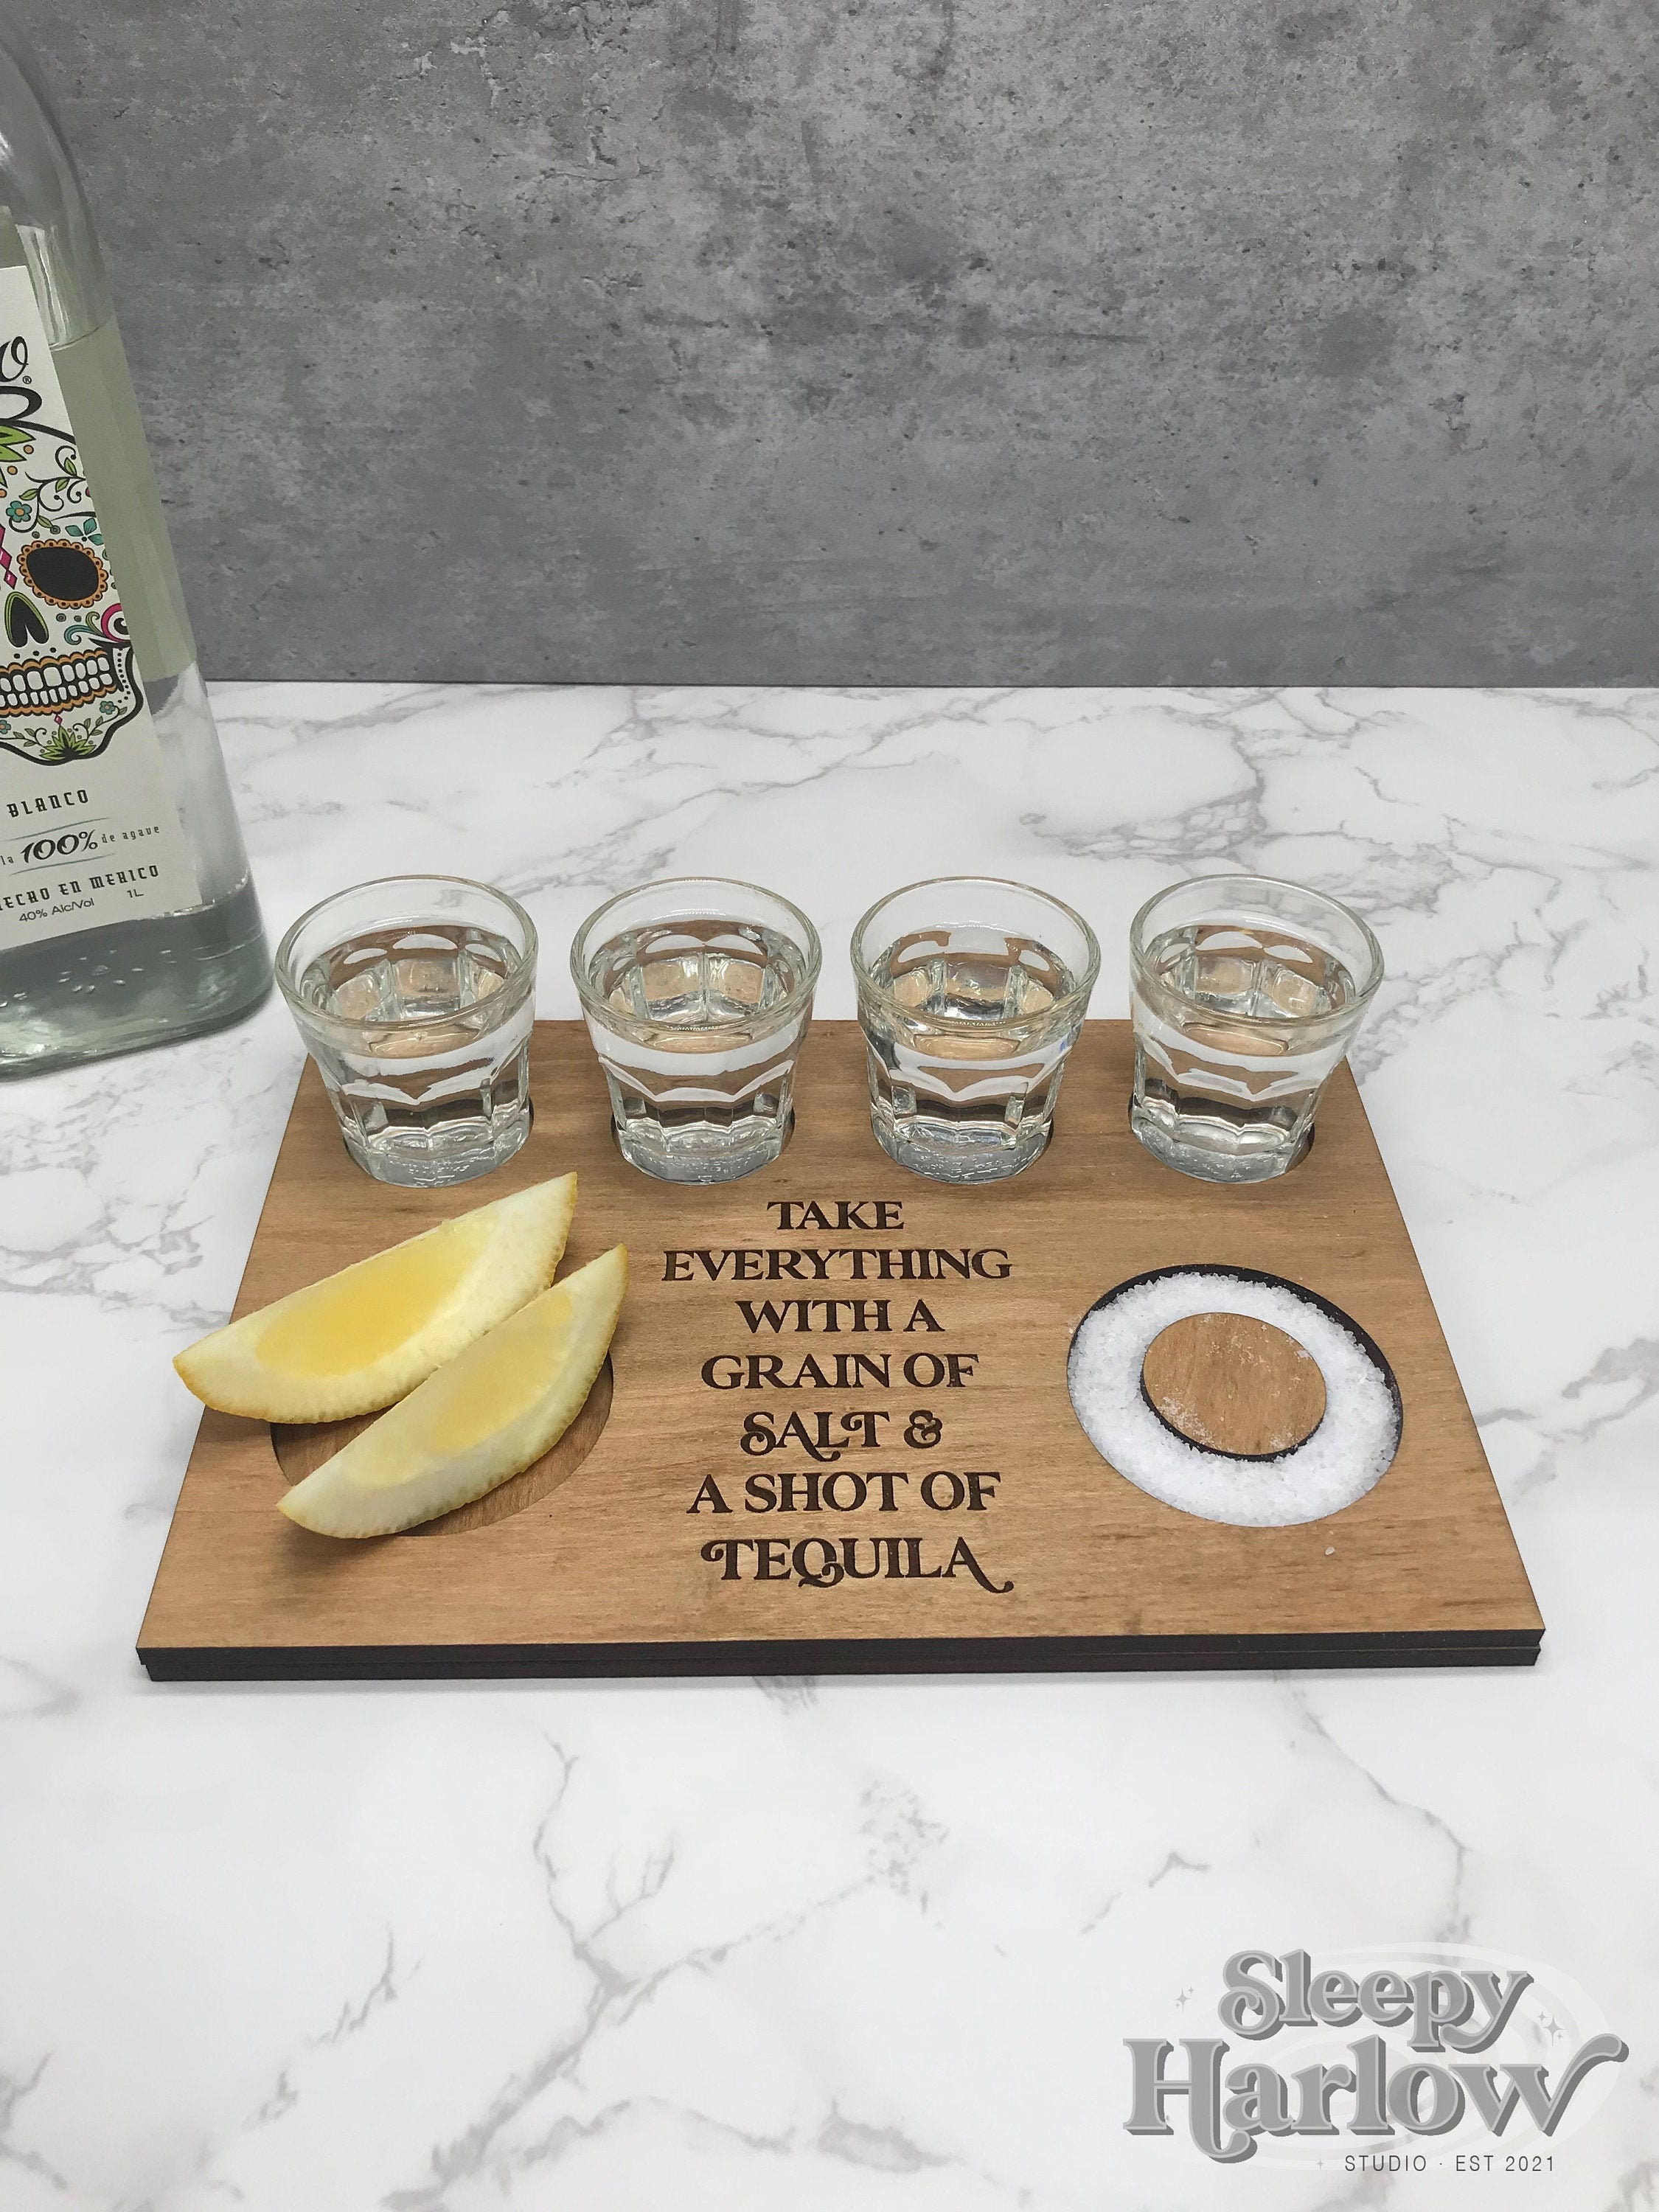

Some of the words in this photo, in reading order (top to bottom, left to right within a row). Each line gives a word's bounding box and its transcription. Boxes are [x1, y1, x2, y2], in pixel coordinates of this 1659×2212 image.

[7, 789, 88, 818] BLANCO
[20, 829, 98, 863] 100%
[101, 833, 116, 844] de
[122, 825, 160, 841] agave
[0, 888, 50, 911] ECHO
[58, 880, 82, 896] EN
[88, 865, 159, 889] MEXICO
[18, 908, 48, 922] 40%
[51, 897, 95, 916] Alc/Vol
[126, 888, 145, 898] 1L
[767, 1200, 905, 1230] TAKE
[661, 1248, 1012, 1281] EVERYTHING
[735, 1299, 893, 1334] WITH
[903, 1298, 945, 1332] A
[700, 1353, 891, 1390] GRAIN
[902, 1352, 979, 1388] OF
[740, 1411, 891, 1462] SALT
[903, 1409, 943, 1450] &
[686, 1473, 733, 1514] A
[744, 1470, 910, 1512] SHOT
[920, 1470, 1001, 1512] OF
[700, 1536, 1015, 1594] TEQUILA
